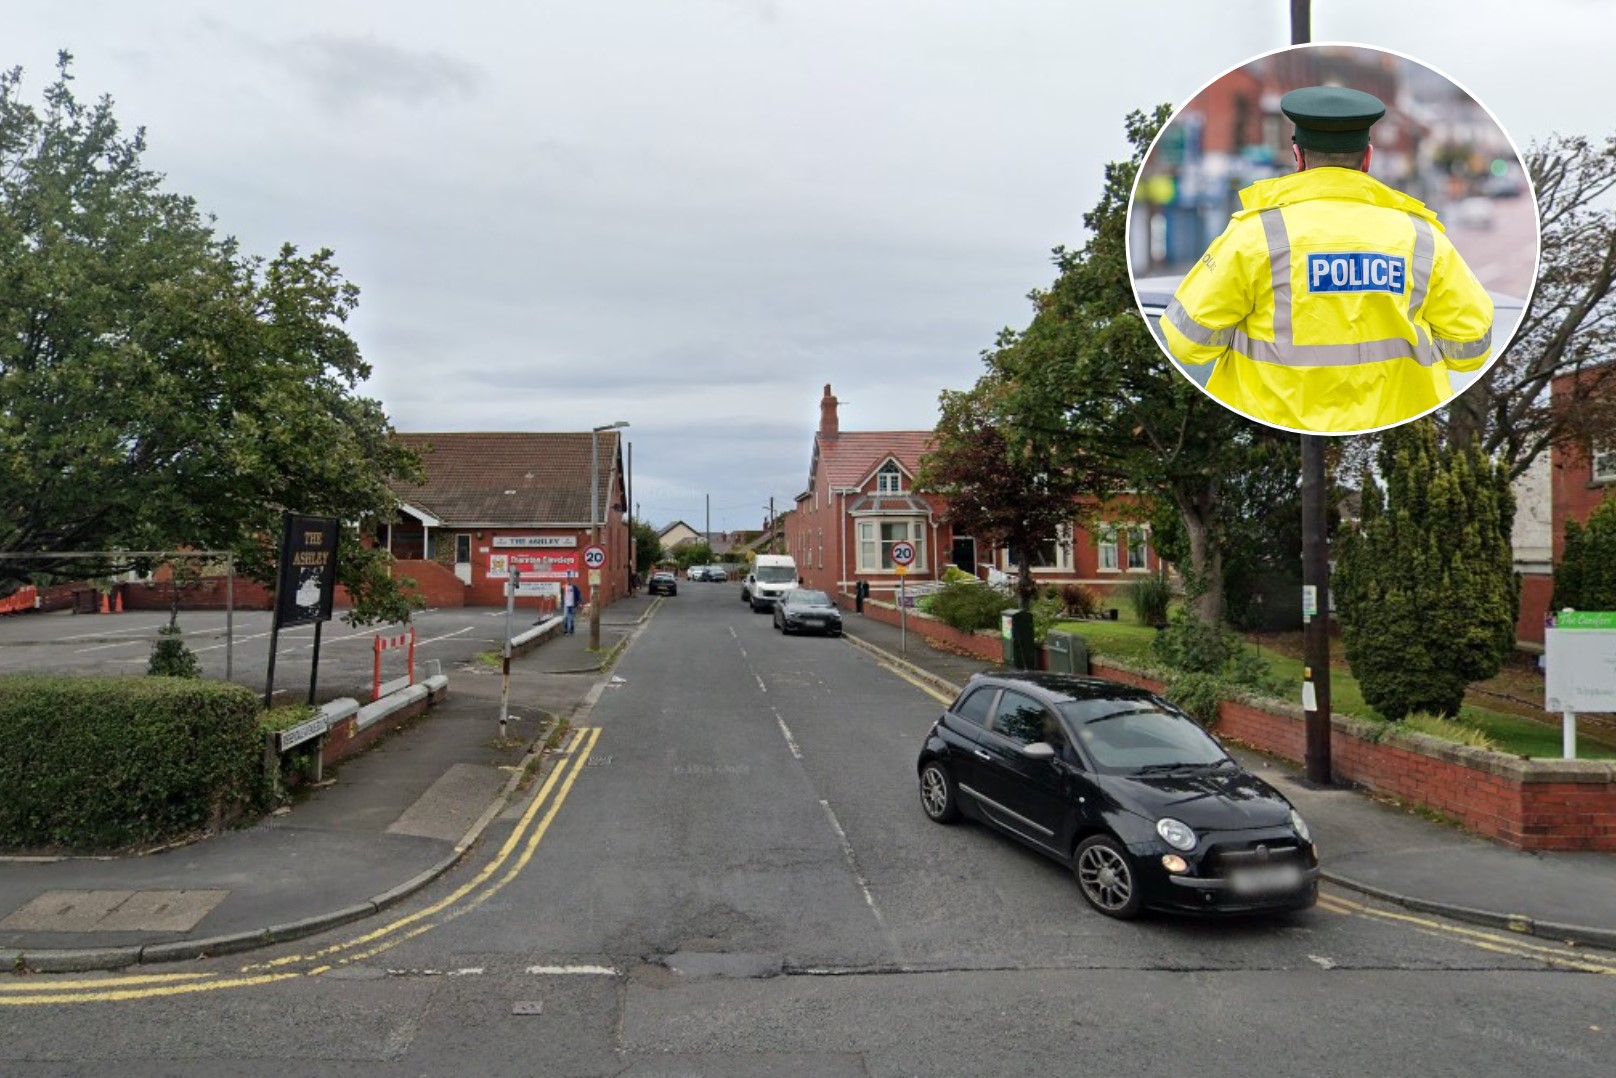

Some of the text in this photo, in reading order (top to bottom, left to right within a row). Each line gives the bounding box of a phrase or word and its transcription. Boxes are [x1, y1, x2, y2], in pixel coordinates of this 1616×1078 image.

[1312, 258, 1402, 288] POLICE
[304, 531, 323, 545] THE
[292, 551, 329, 566] ASHLEY
[586, 552, 603, 563] 20
[895, 548, 911, 559] 20
